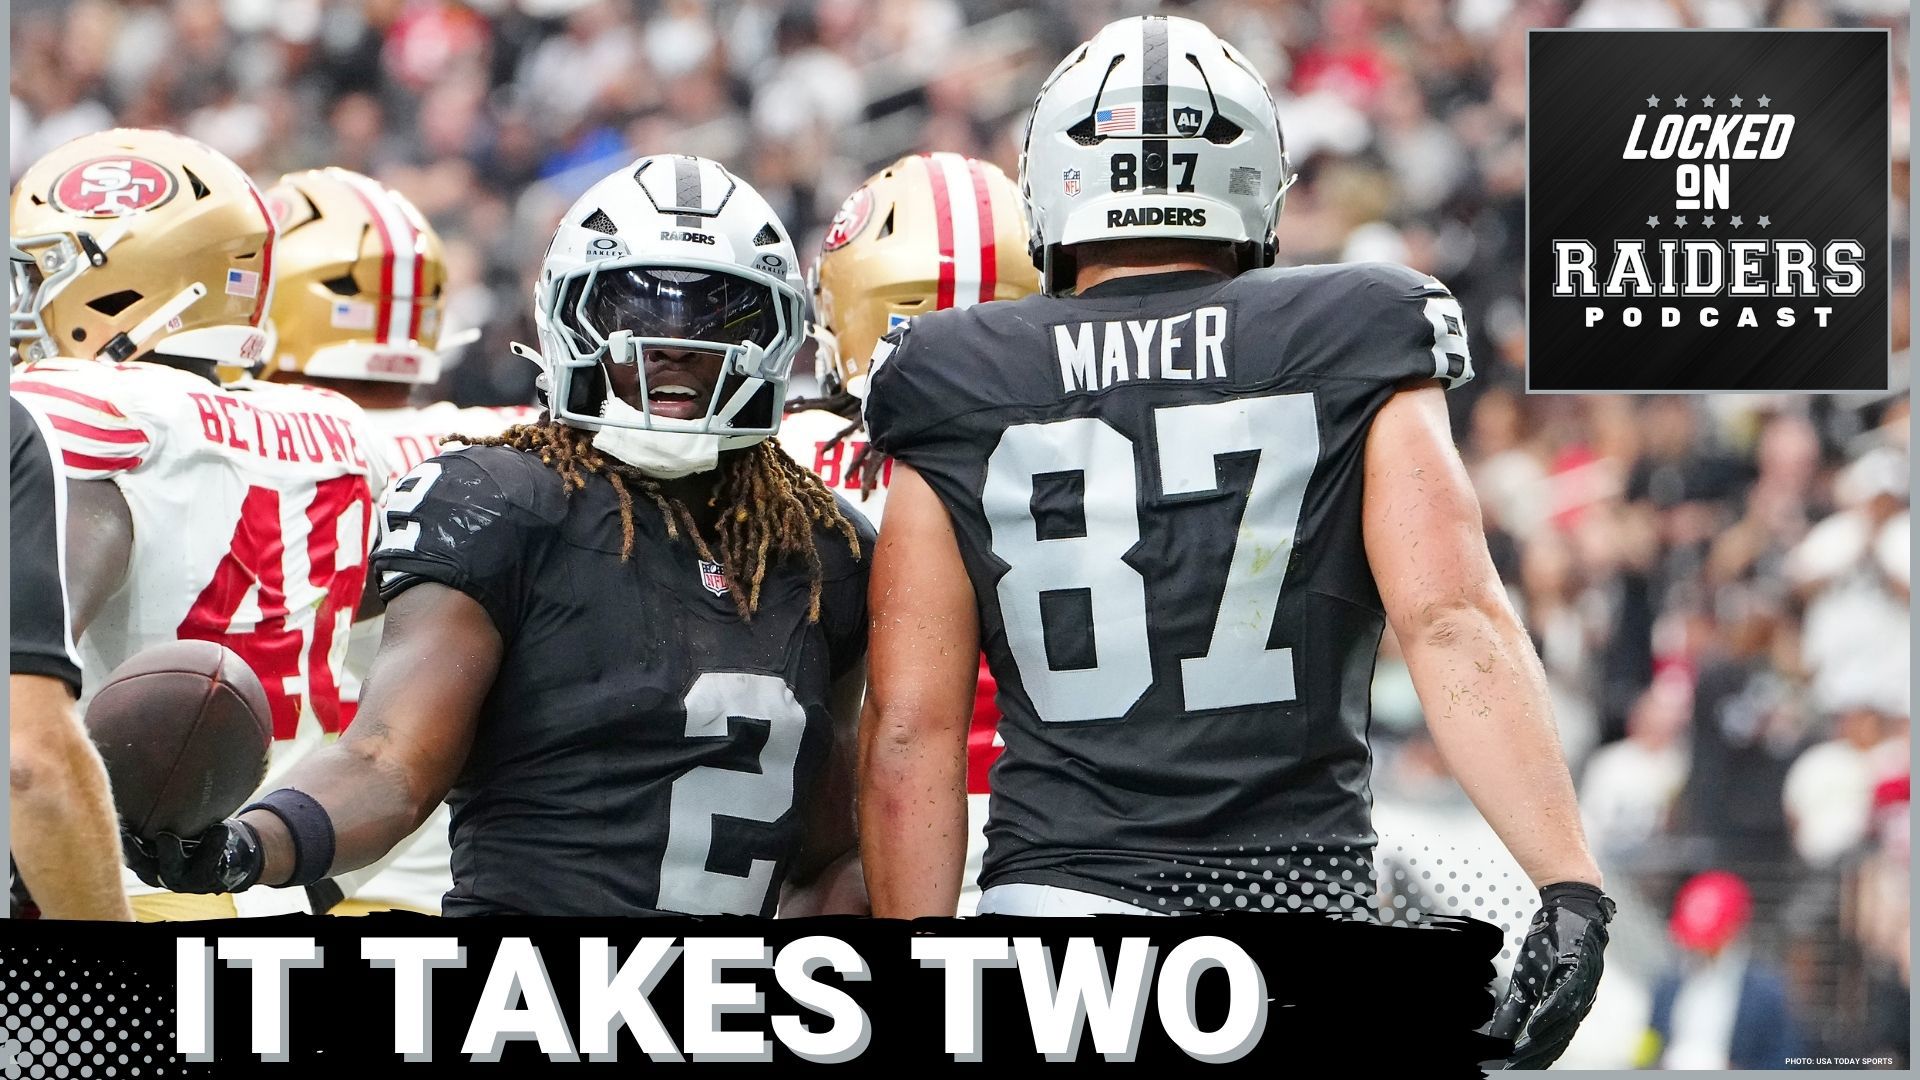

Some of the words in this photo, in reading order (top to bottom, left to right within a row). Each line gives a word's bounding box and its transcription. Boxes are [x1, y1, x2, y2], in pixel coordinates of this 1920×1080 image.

[1177, 112, 1200, 128] AL
[660, 231, 716, 246] RAIDERS
[1107, 207, 1207, 229] RAIDERS
[1053, 306, 1228, 394] MAYER
[188, 392, 368, 470] BETHUNE
[704, 573, 727, 589] NFL
[982, 392, 1320, 723] 87
[177, 473, 372, 741] 48
[656, 672, 807, 915] 2
